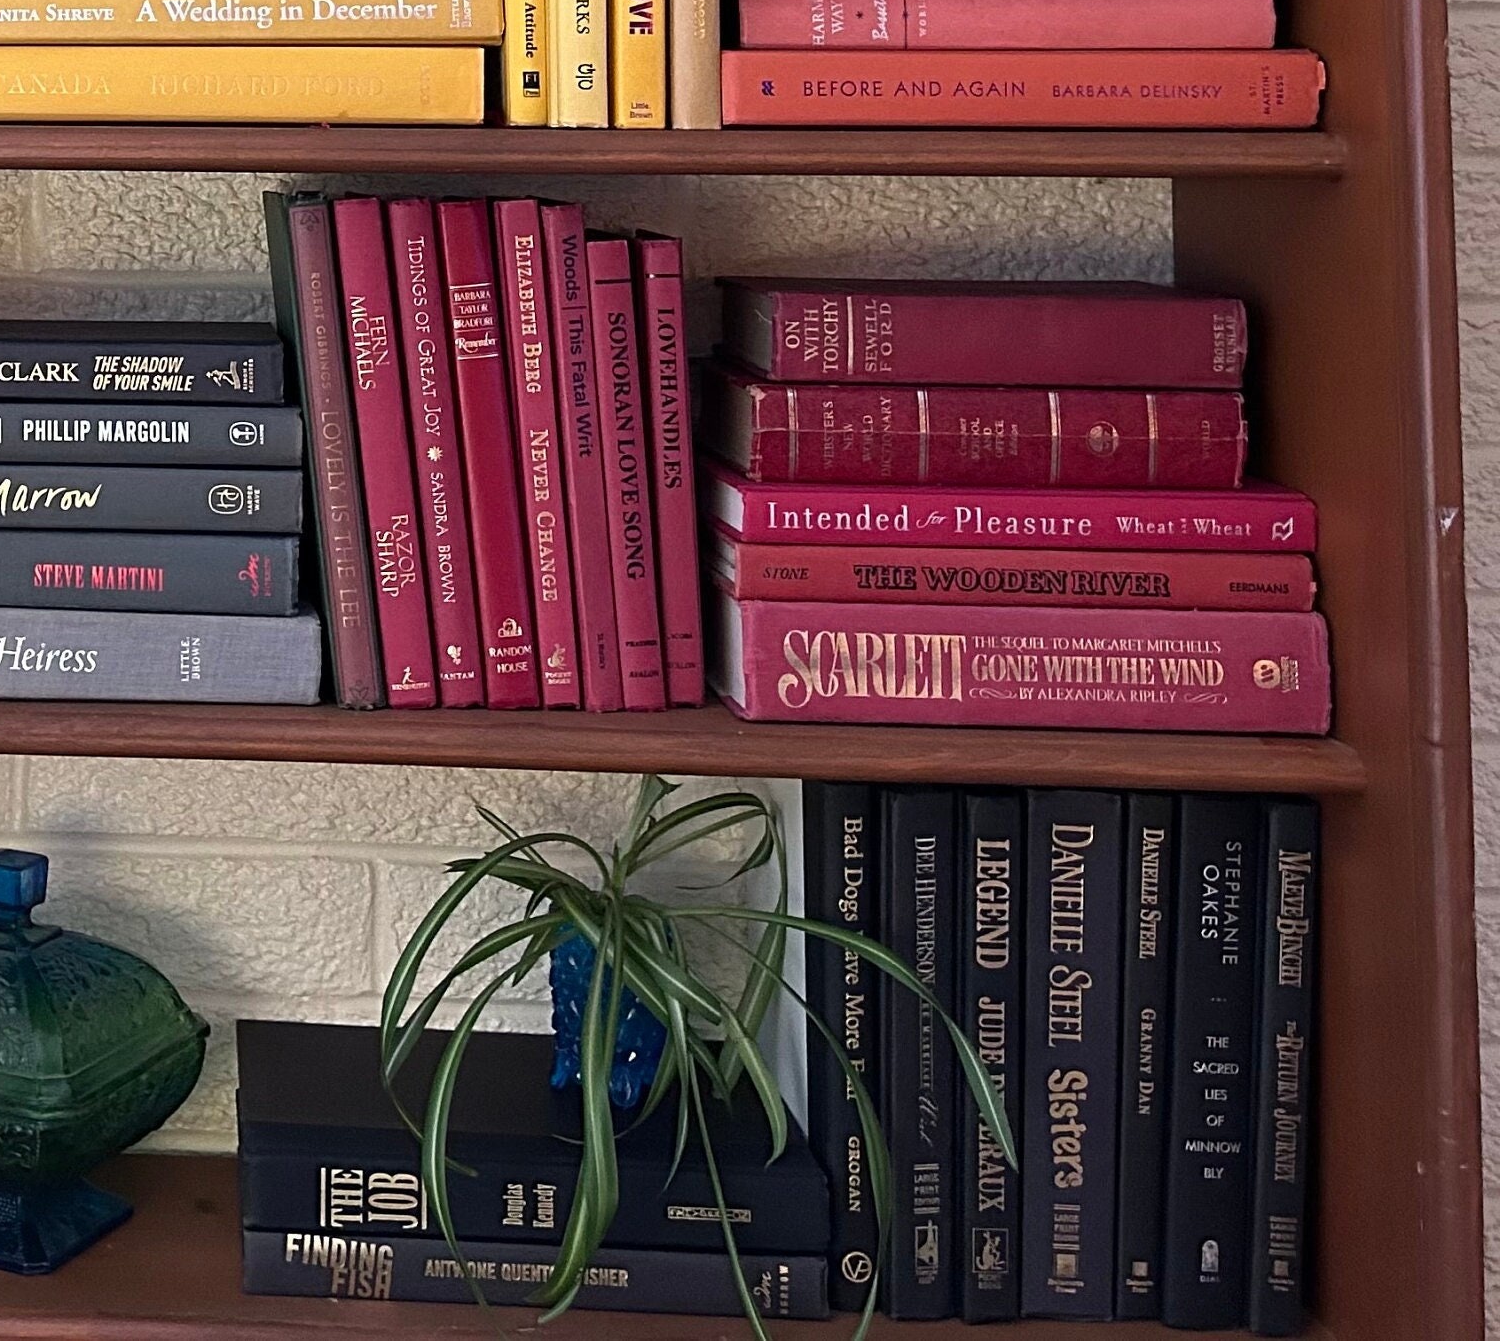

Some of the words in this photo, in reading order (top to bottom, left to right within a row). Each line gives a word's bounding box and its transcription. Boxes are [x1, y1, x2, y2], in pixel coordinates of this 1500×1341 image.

[45, 5, 115, 22] SHREVE
[136, 1, 158, 22] A
[163, 0, 273, 29] Wedding
[280, 0, 304, 22] in
[312, 0, 438, 22] December
[524, 4, 539, 58] Attitude
[514, 235, 540, 336] ELIZABETH
[93, 357, 119, 372] THE
[121, 357, 184, 373] SHADOW
[522, 341, 542, 394] BERG
[93, 375, 112, 389] OF
[114, 375, 149, 391] YOUR
[152, 376, 194, 392] SMILE
[657, 308, 682, 489] LOVEHANDLES
[23, 420, 92, 442] PHILLIP
[98, 421, 190, 443] MARGOLIN
[529, 430, 549, 502] NEVER
[768, 503, 909, 532] Intended
[916, 511, 947, 528] for
[954, 508, 1092, 537] Pleasure
[1116, 517, 1175, 535] Wheat
[1193, 519, 1252, 537] Wheat
[535, 511, 558, 602] CHANGE
[1229, 582, 1289, 594] EERDMANS
[489, 646, 532, 658] RANDOM
[497, 662, 528, 673] HOUSE
[972, 654, 1038, 684] GONE
[1042, 655, 1105, 685] WITH
[1106, 656, 1156, 685] THE
[1159, 657, 1224, 687] WIND
[1200, 864, 1220, 940] OAKES
[1222, 841, 1241, 966] STEPHANIE
[1206, 1036, 1229, 1049] THE
[1193, 1062, 1239, 1075] SACRED
[1204, 1088, 1227, 1101] LIES
[1047, 1068, 1088, 1189] Sisters
[1206, 1115, 1224, 1127] OF
[1185, 1140, 1241, 1154] MINNOW
[847, 1136, 860, 1213] GROGAN
[1203, 1167, 1223, 1179] BLY
[332, 1168, 364, 1228] THE
[368, 1172, 418, 1229] JOB
[502, 1183, 524, 1227] Douglas
[532, 1183, 556, 1229] Kennedy
